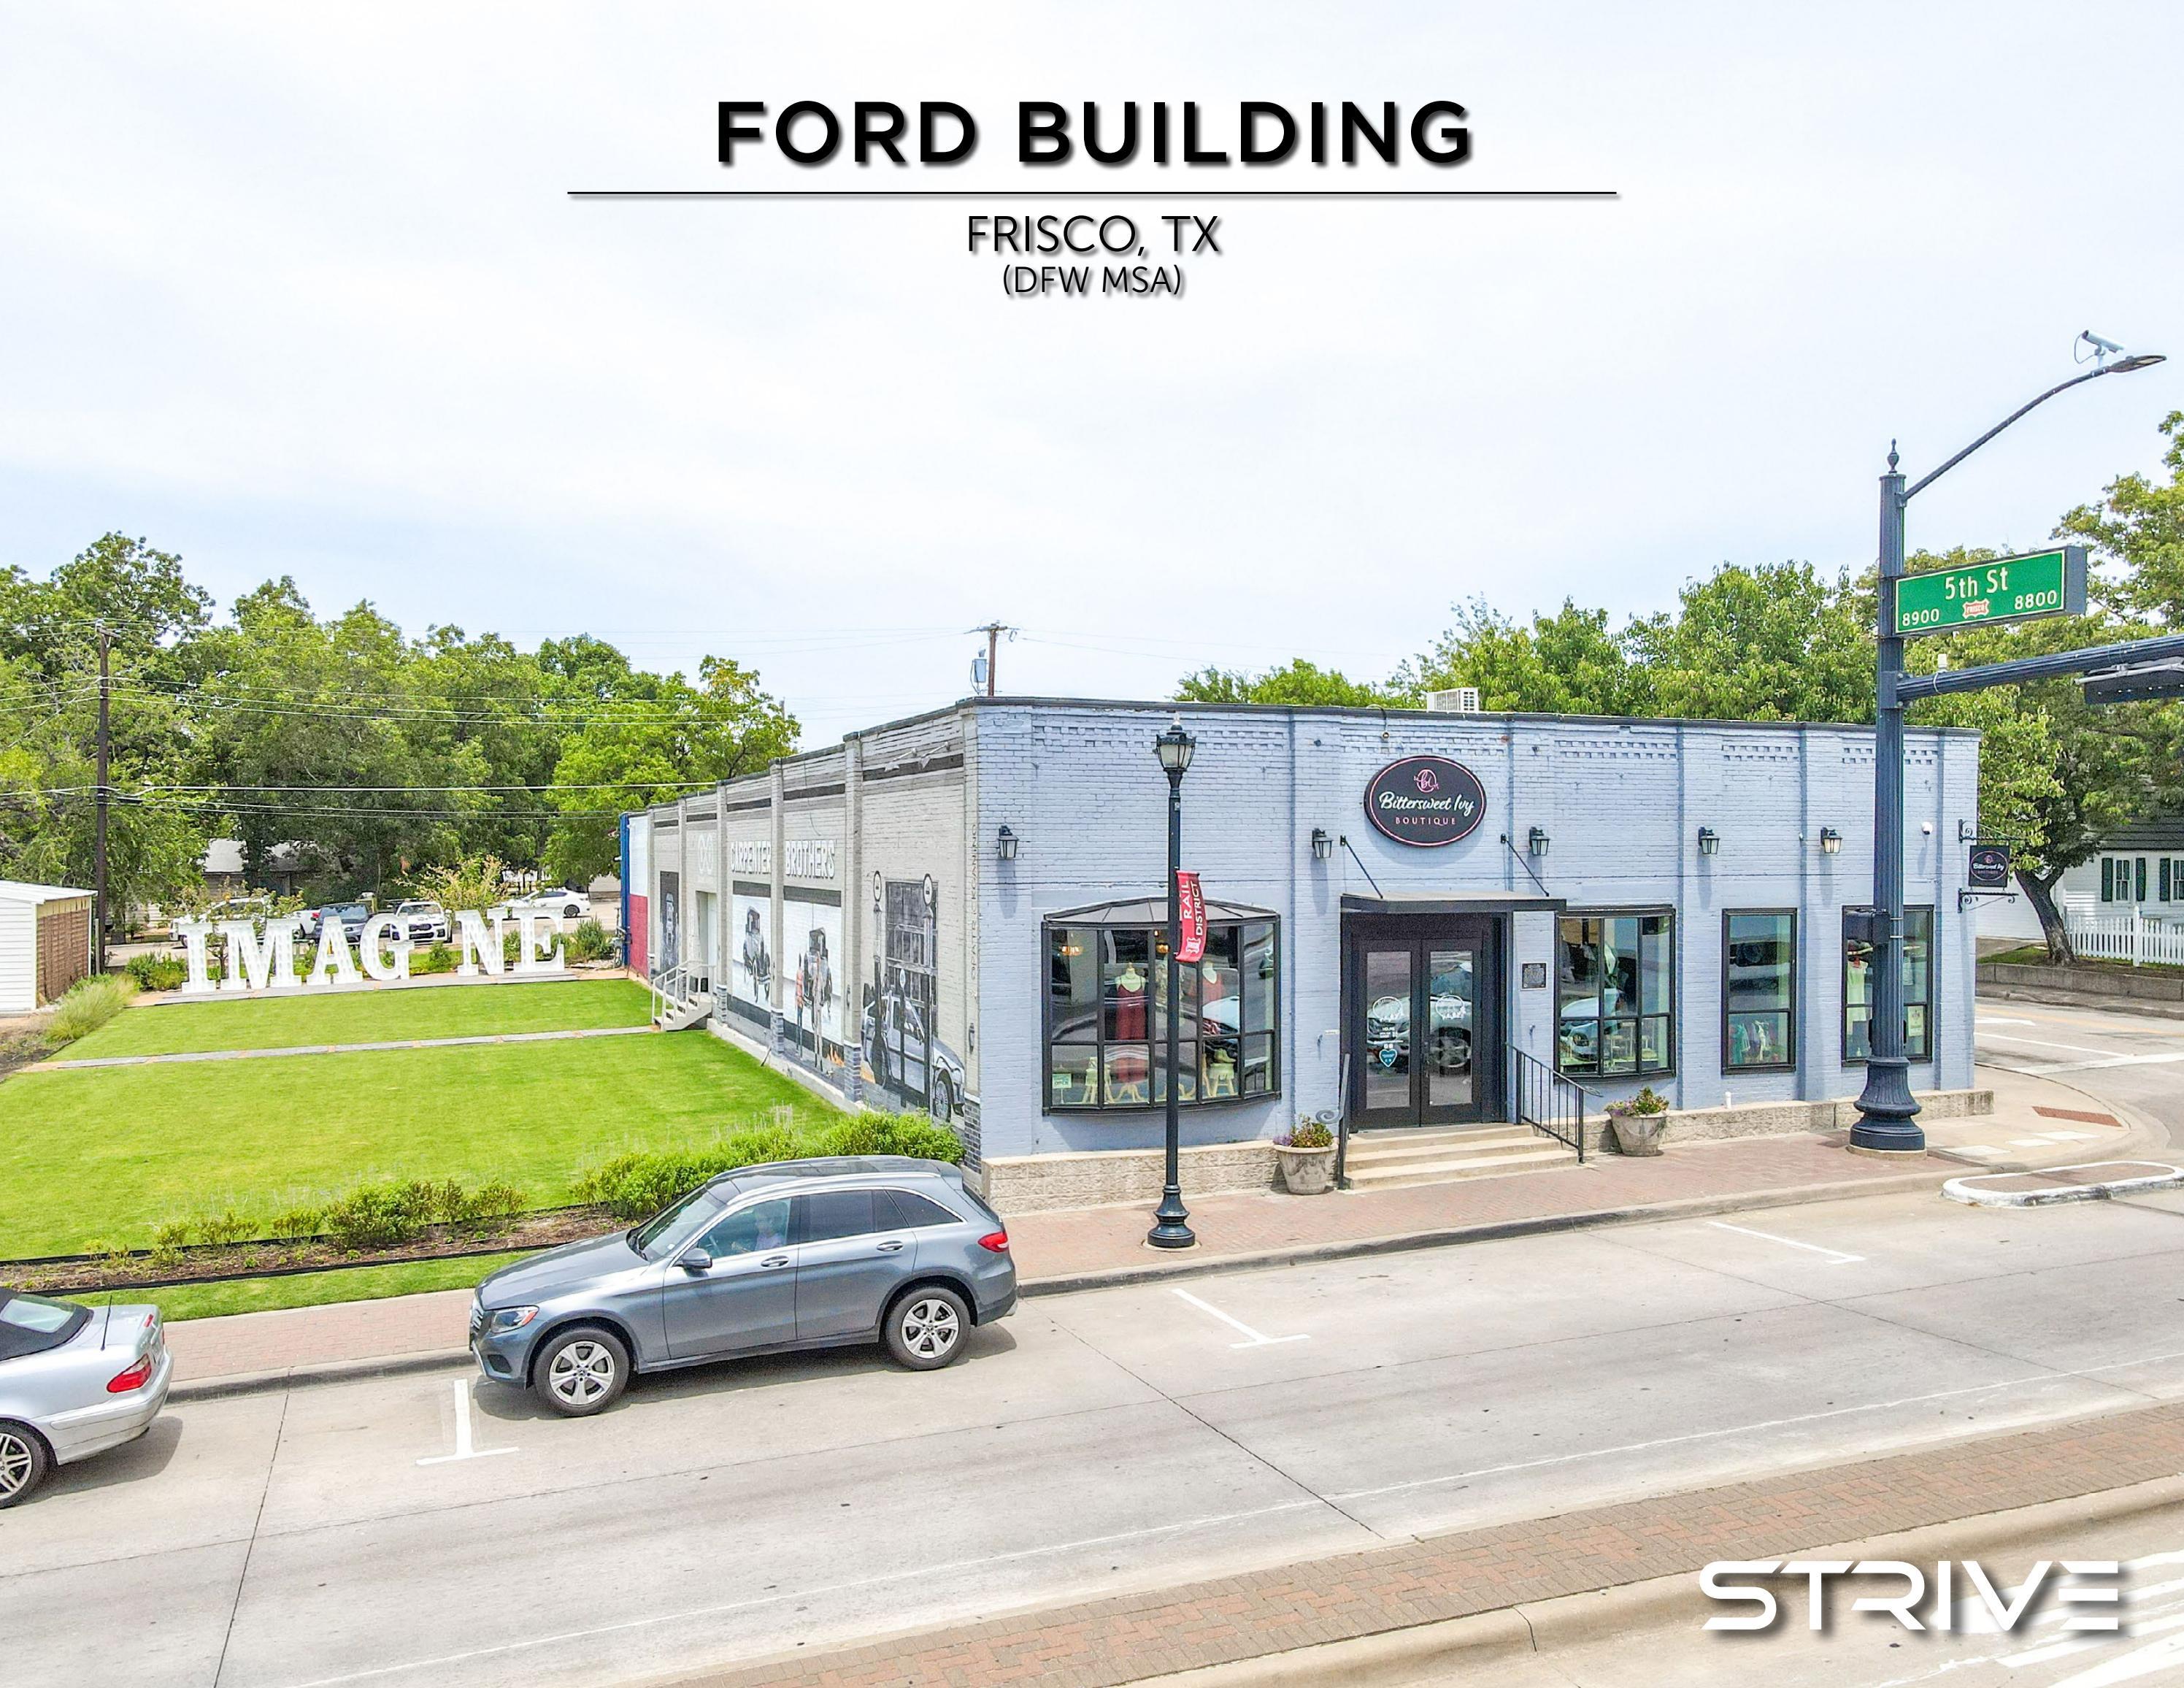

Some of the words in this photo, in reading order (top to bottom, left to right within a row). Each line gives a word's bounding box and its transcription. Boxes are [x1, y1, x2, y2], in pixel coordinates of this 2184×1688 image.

[1945, 576, 1977, 599] 5th
[1986, 566, 2008, 594] St
[2014, 590, 2058, 610] 8800
[1902, 608, 1940, 626] 8900
[1379, 791, 1451, 810] Bittersweet
[1454, 794, 1474, 817] Ivy
[1396, 817, 1456, 826] BOUTIQUE
[1181, 881, 1192, 919] RAIL
[1191, 881, 1204, 936] DISTRICT
